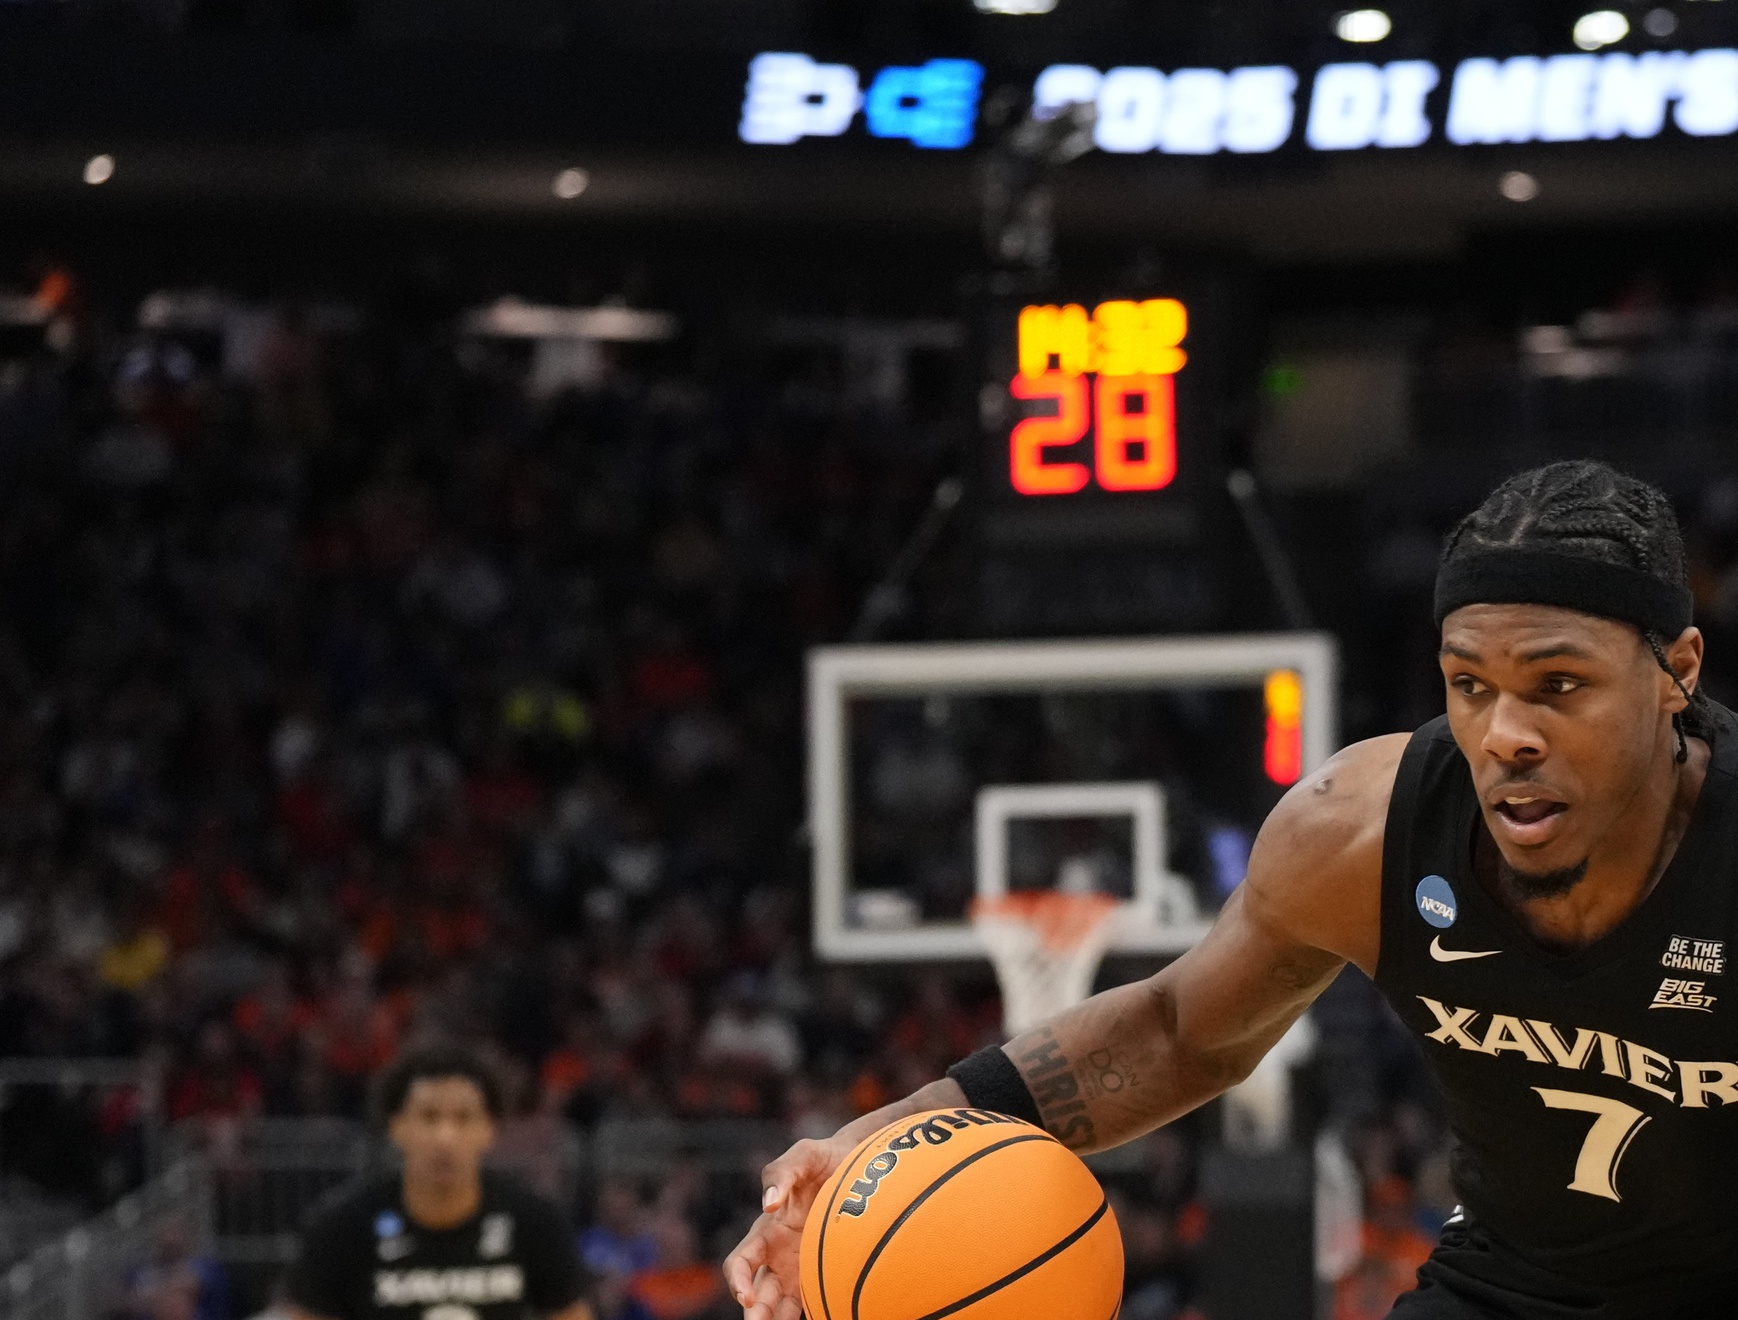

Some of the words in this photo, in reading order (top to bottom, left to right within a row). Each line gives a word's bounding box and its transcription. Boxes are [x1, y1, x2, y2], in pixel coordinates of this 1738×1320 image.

[1304, 59, 1440, 151] DI
[1009, 374, 1178, 496] 28
[1421, 896, 1454, 921] NCAA
[1668, 937, 1689, 955] BE
[1693, 941, 1723, 958] THE
[1661, 952, 1724, 974] CHANGE
[1659, 978, 1705, 994] BIG
[1652, 990, 1718, 1007] EAST
[1530, 1086, 1653, 1203] 7
